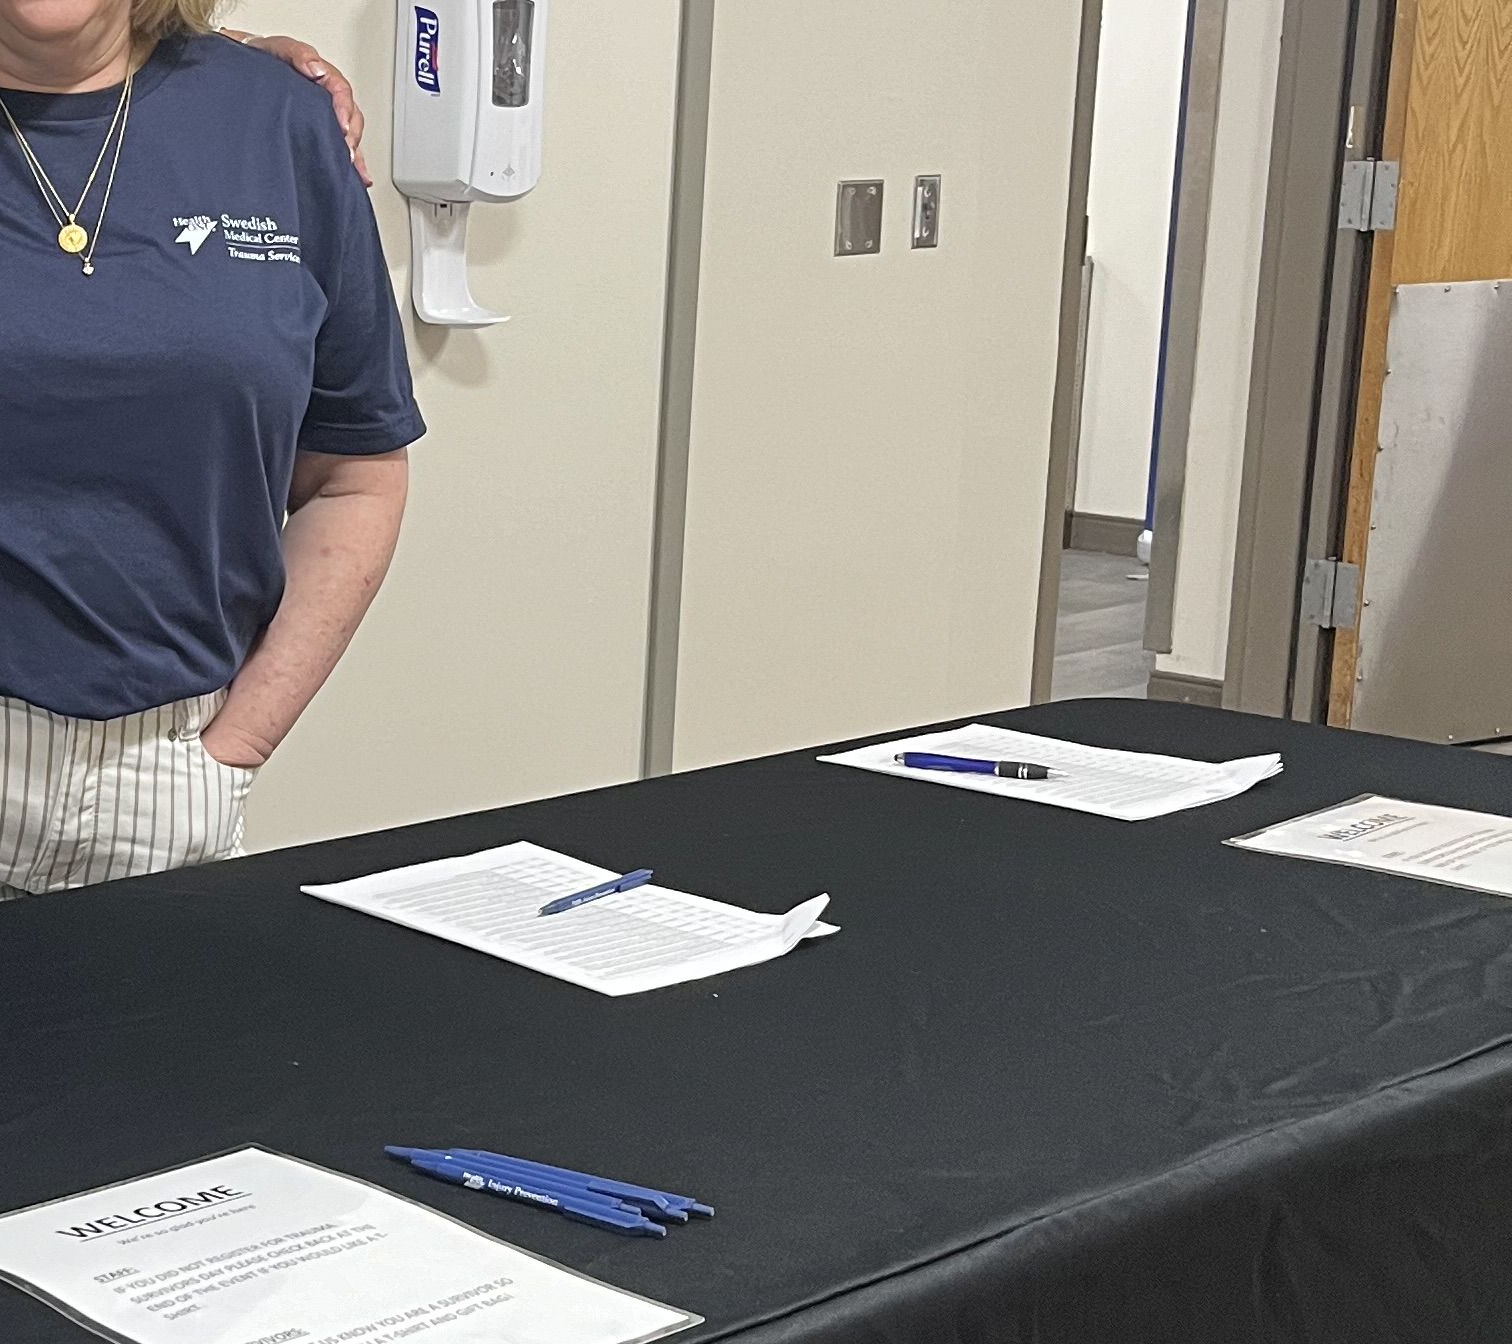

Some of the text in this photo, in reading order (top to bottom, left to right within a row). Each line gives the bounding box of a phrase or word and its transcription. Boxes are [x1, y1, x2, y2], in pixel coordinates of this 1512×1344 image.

[220, 213, 278, 231] Swedish
[223, 229, 299, 245] Medical Center
[227, 246, 266, 261] Trauma
[55, 1184, 245, 1239] WELCOME
[198, 1268, 225, 1280] DAY
[224, 1255, 268, 1271] PLEASE
[267, 1243, 306, 1258] CHECK
[304, 1234, 338, 1247] BACK
[336, 1229, 353, 1239] AT
[126, 1277, 156, 1289] YOU
[155, 1269, 179, 1281] DID
[178, 1260, 206, 1272] NOT
[147, 1299, 176, 1312] END
[218, 1270, 258, 1288] EVENT
[268, 1258, 298, 1270] YOU
[296, 1246, 343, 1262] WOULD
[340, 1238, 368, 1250] LIKE
[337, 1323, 378, 1341] KNOW
[375, 1314, 405, 1326] YOU
[404, 1307, 430, 1319] ARE
[436, 1283, 498, 1308] SURVIVOR
[493, 1277, 514, 1287] SO
[429, 1313, 457, 1326] AND
